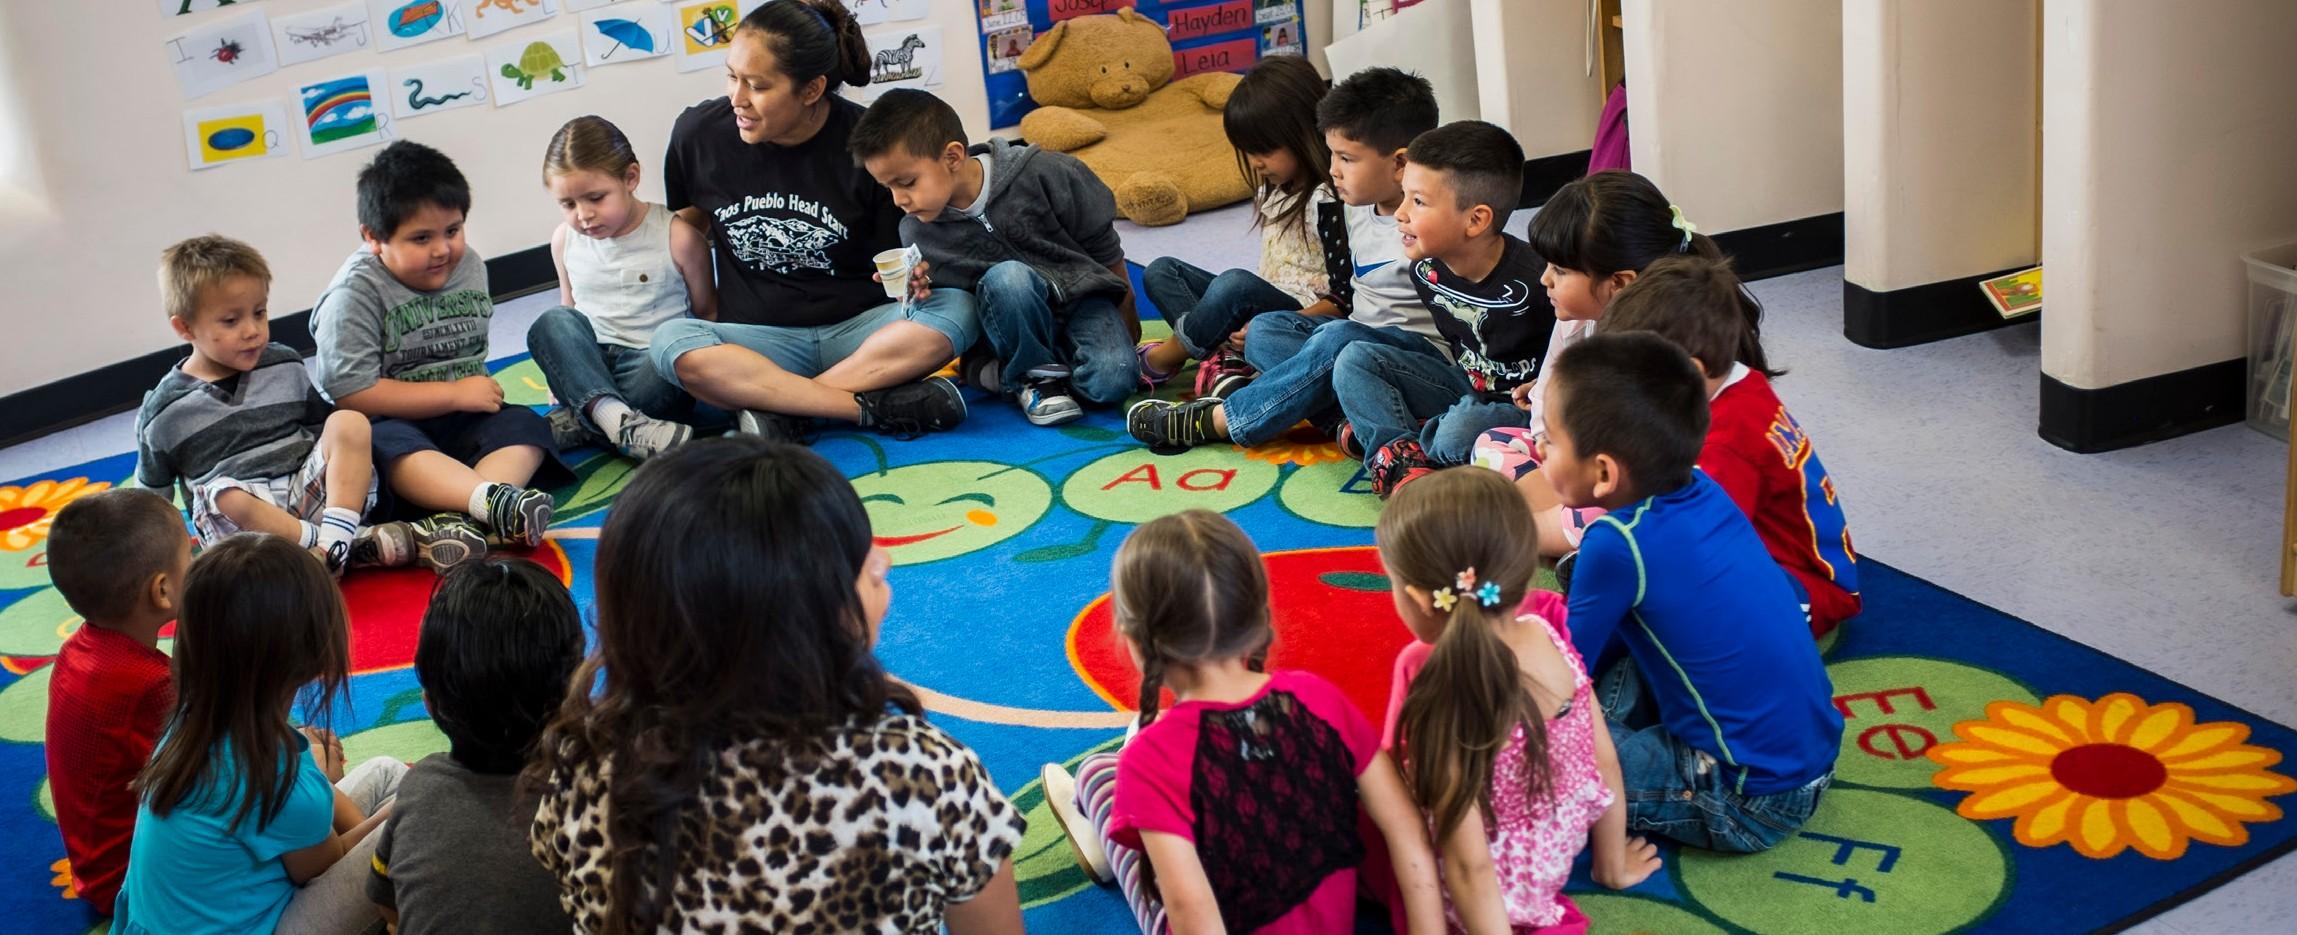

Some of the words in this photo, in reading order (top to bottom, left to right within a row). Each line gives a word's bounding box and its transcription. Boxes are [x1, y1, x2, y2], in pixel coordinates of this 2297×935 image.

[355, 20, 368, 47] J
[1174, 5, 1247, 34] Hayden
[1182, 49, 1230, 74] Leia
[743, 192, 785, 213] Pueblo
[788, 194, 819, 218] Head
[821, 207, 849, 240] Start
[385, 290, 493, 352] UNIVERSITY
[1101, 463, 1237, 492] Aa
[1832, 686, 1938, 760] Ee
[1773, 831, 1902, 903] Ff
